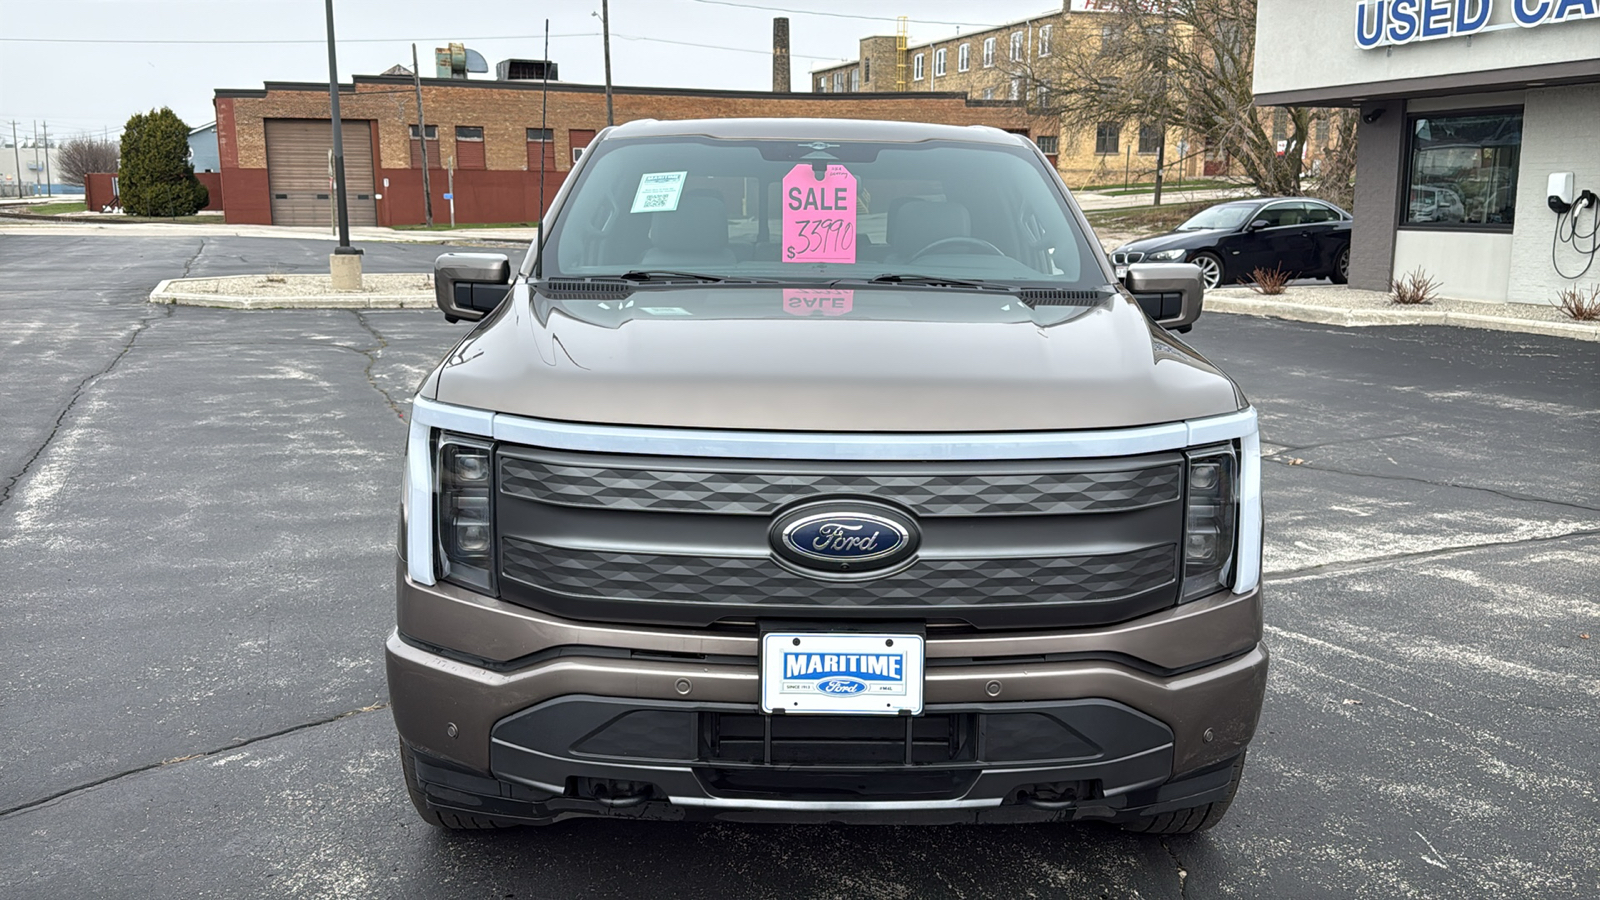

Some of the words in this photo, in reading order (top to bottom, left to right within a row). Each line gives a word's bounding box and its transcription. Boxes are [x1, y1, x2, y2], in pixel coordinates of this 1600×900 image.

[1354, 0, 1492, 50] USED
[1511, 0, 1600, 28] CA
[788, 187, 848, 211] SALE
[812, 523, 880, 551] Ford
[786, 654, 901, 679] MARITIME
[825, 680, 858, 693] Ford
